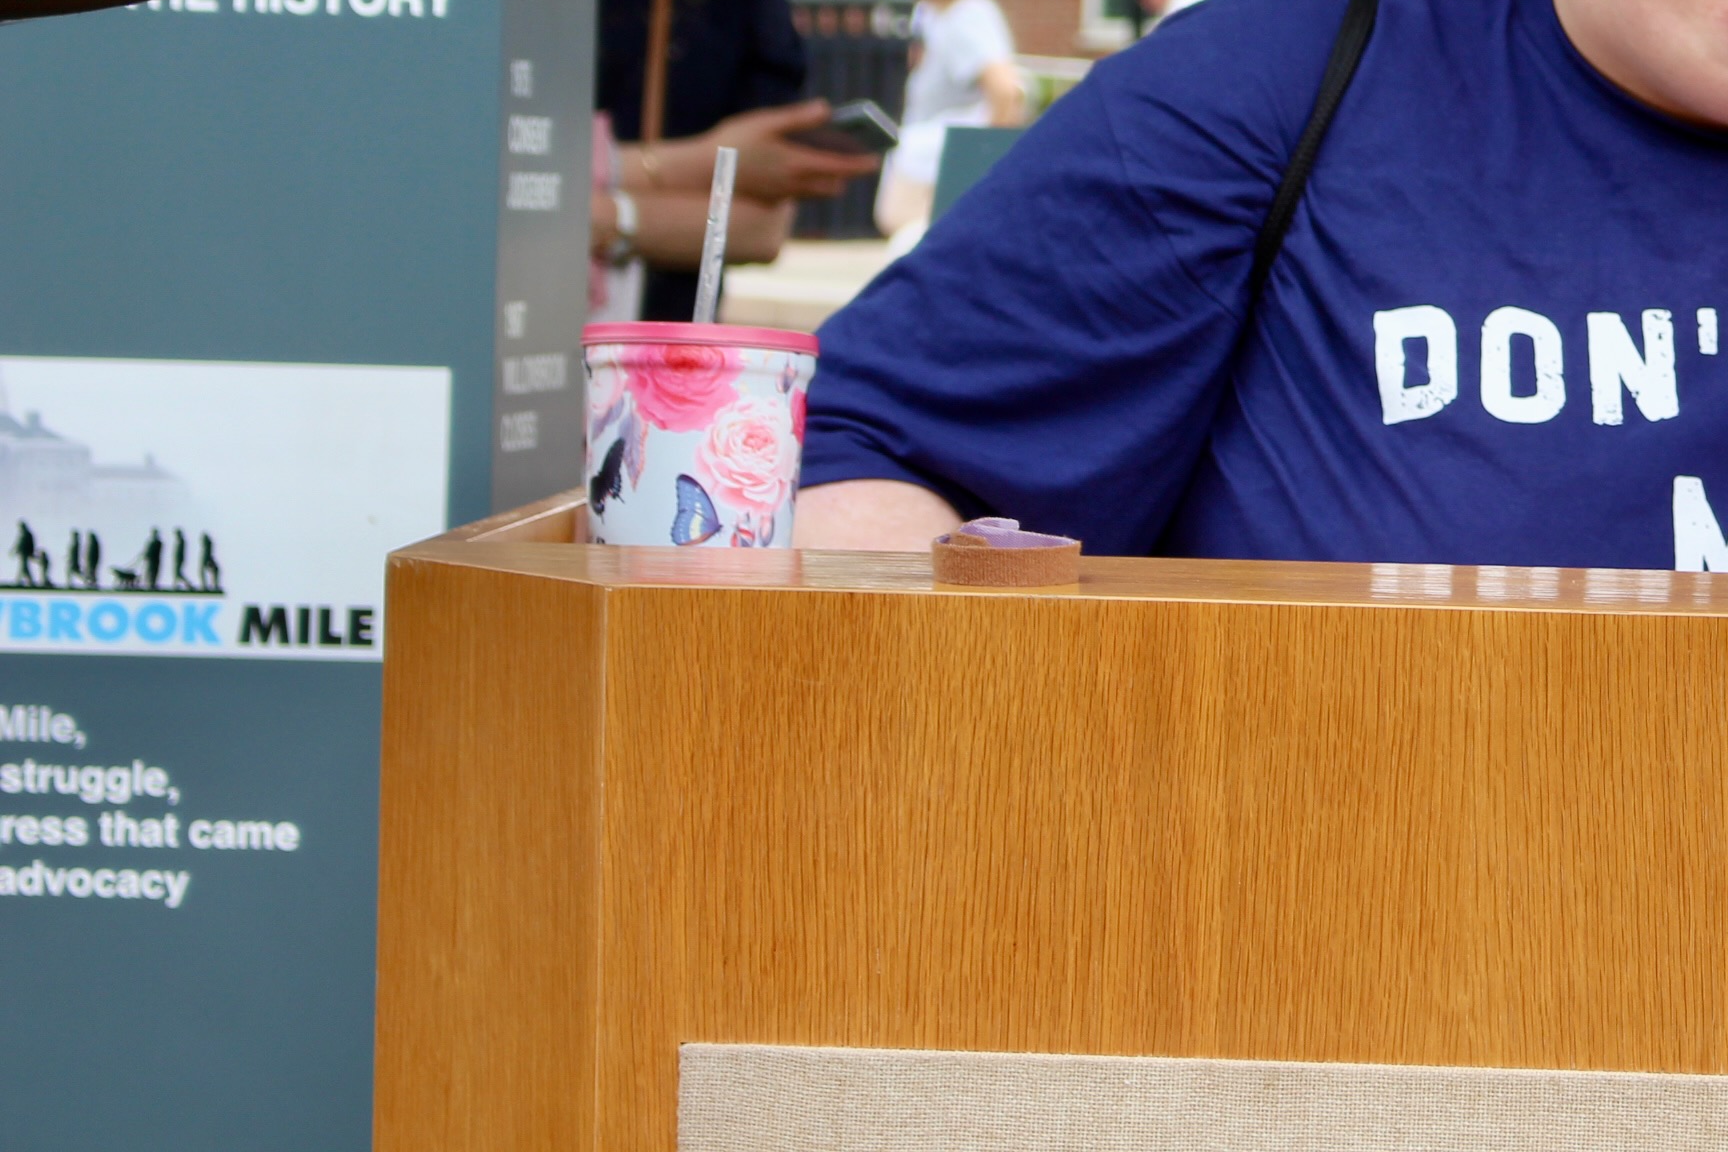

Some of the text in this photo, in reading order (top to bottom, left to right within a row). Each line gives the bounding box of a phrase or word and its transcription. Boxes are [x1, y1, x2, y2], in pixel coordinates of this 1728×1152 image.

[0, 600, 375, 646] BROOK MILE
[0, 704, 87, 749] Mile,
[0, 758, 181, 806] struggle,
[0, 810, 301, 851] ress that came
[0, 859, 191, 909] advocacy
